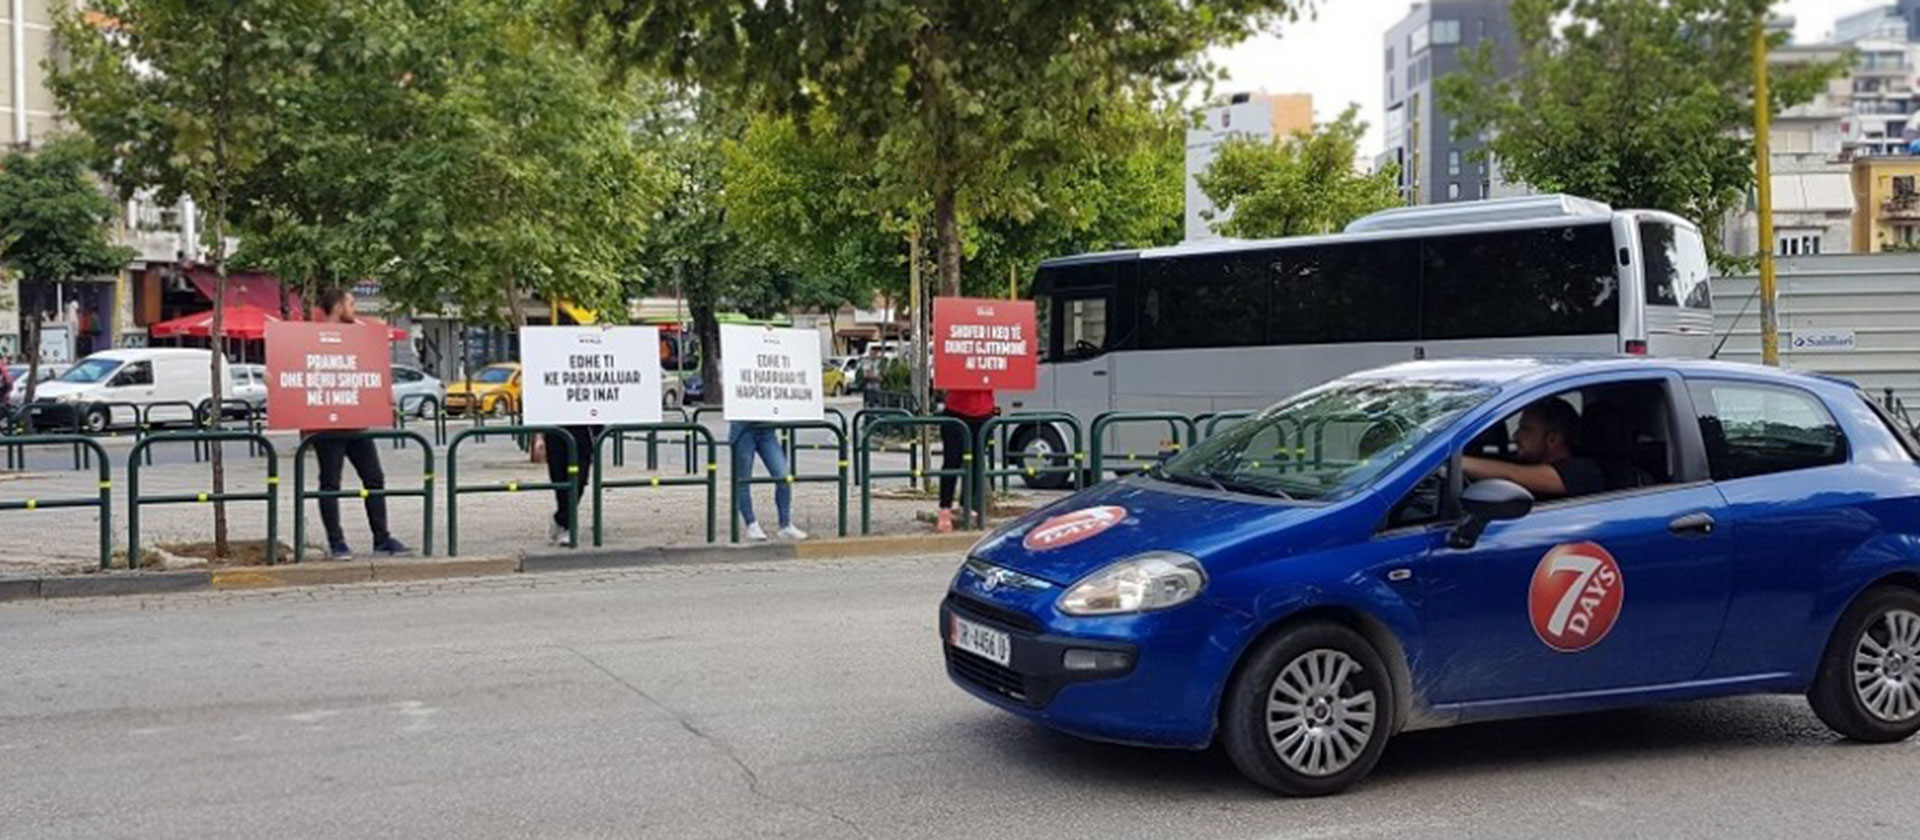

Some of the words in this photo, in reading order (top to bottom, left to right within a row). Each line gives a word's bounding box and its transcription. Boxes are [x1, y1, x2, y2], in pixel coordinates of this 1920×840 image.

[569, 354, 600, 369] EDHE
[603, 354, 615, 368] TI
[781, 355, 791, 369] TI
[544, 372, 559, 386] KE
[562, 370, 641, 385] PARAKALUAR
[593, 386, 619, 401] INAT
[1548, 554, 1603, 637] 7
[1568, 565, 1617, 636] DAYS
